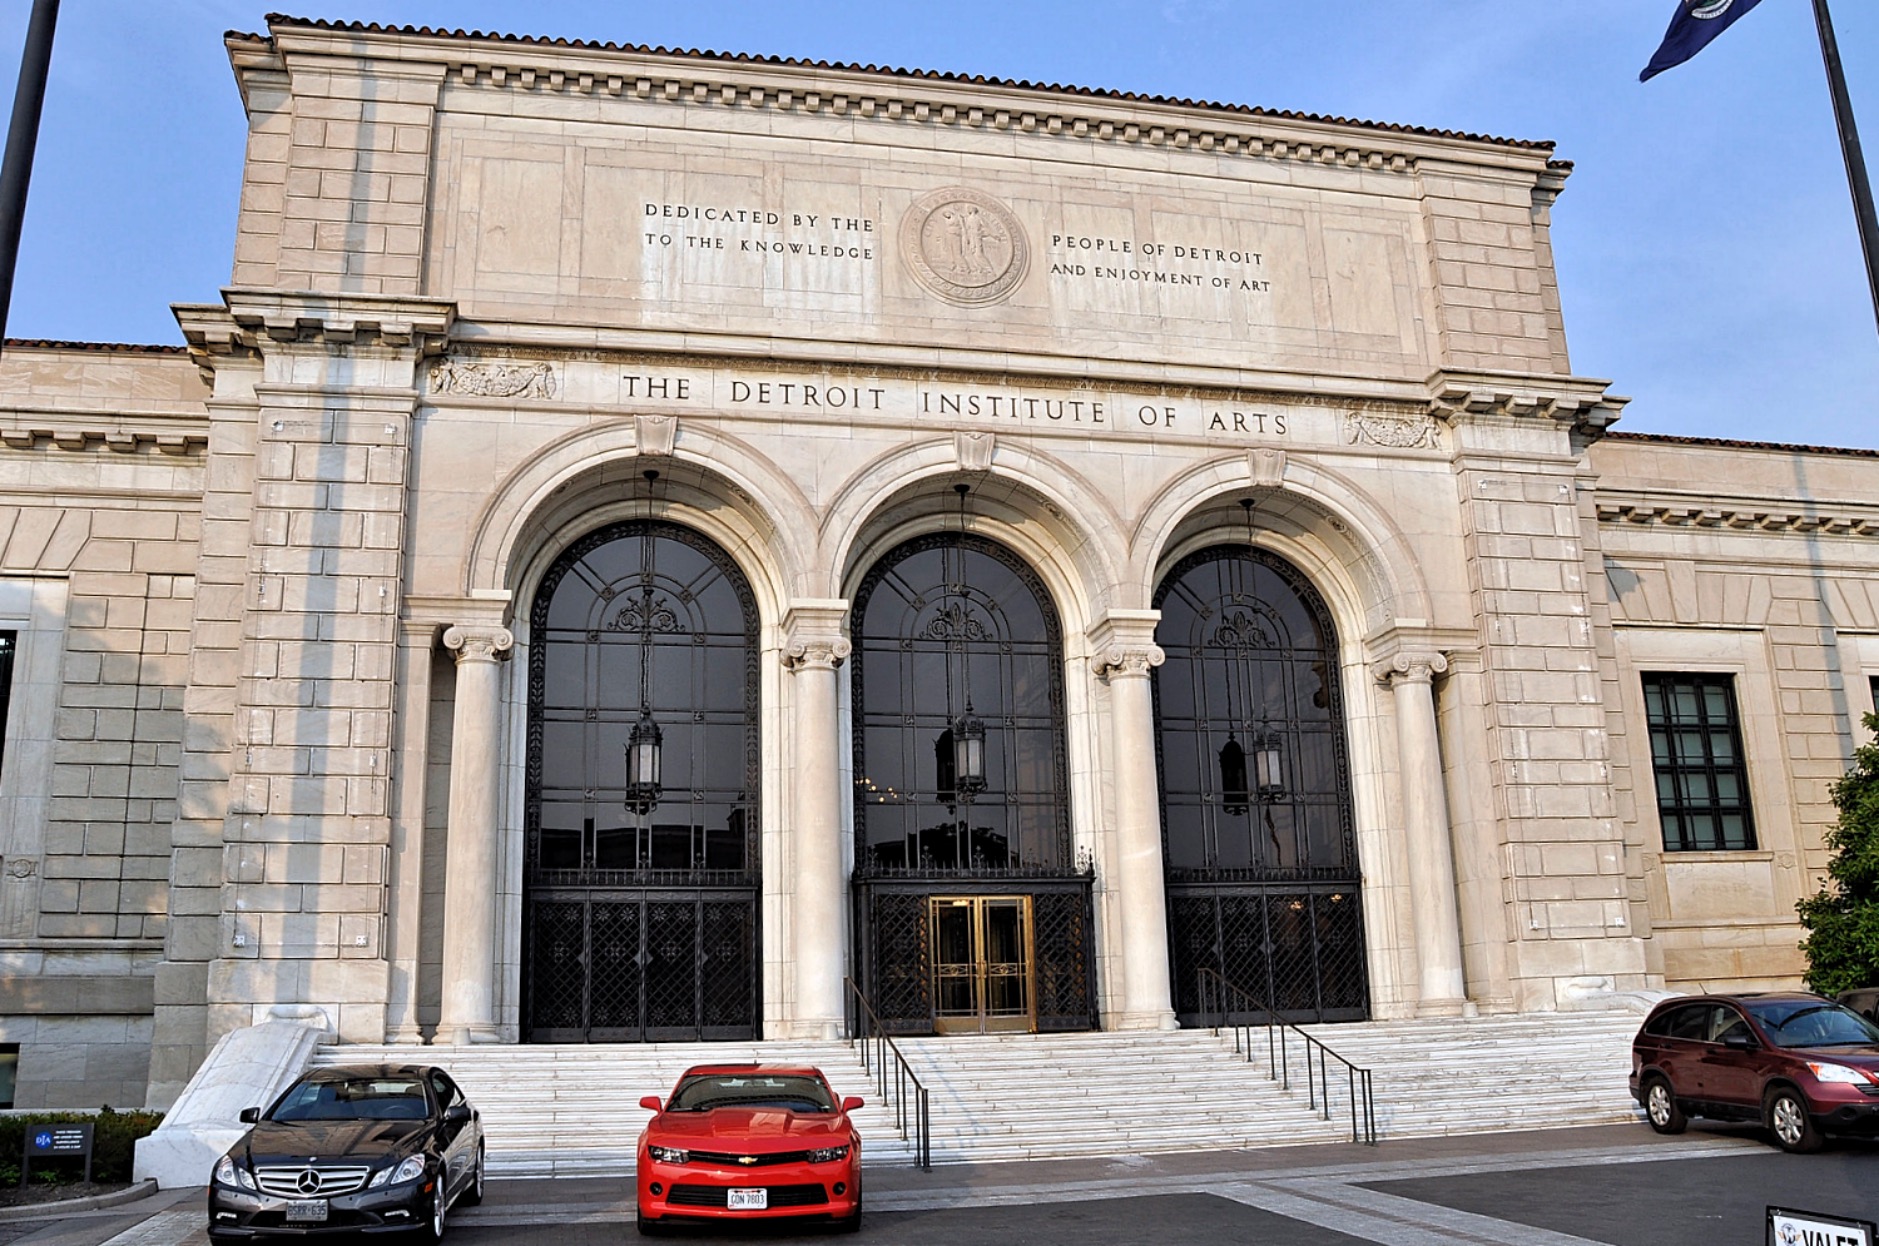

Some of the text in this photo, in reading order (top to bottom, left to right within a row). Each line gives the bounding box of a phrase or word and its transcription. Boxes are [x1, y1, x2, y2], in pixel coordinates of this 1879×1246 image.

[645, 203, 873, 232] DEDICATED BY THE
[645, 233, 873, 260] TO THE KNOWLEDGE
[1052, 235, 1262, 265] PEOPLE OF DETROIT
[1050, 263, 1270, 292] AND ENJOYMENT OF ART
[623, 375, 1287, 436] THE DETROIT INSTITUTE OF ARTS
[35, 1135, 51, 1146] DIA
